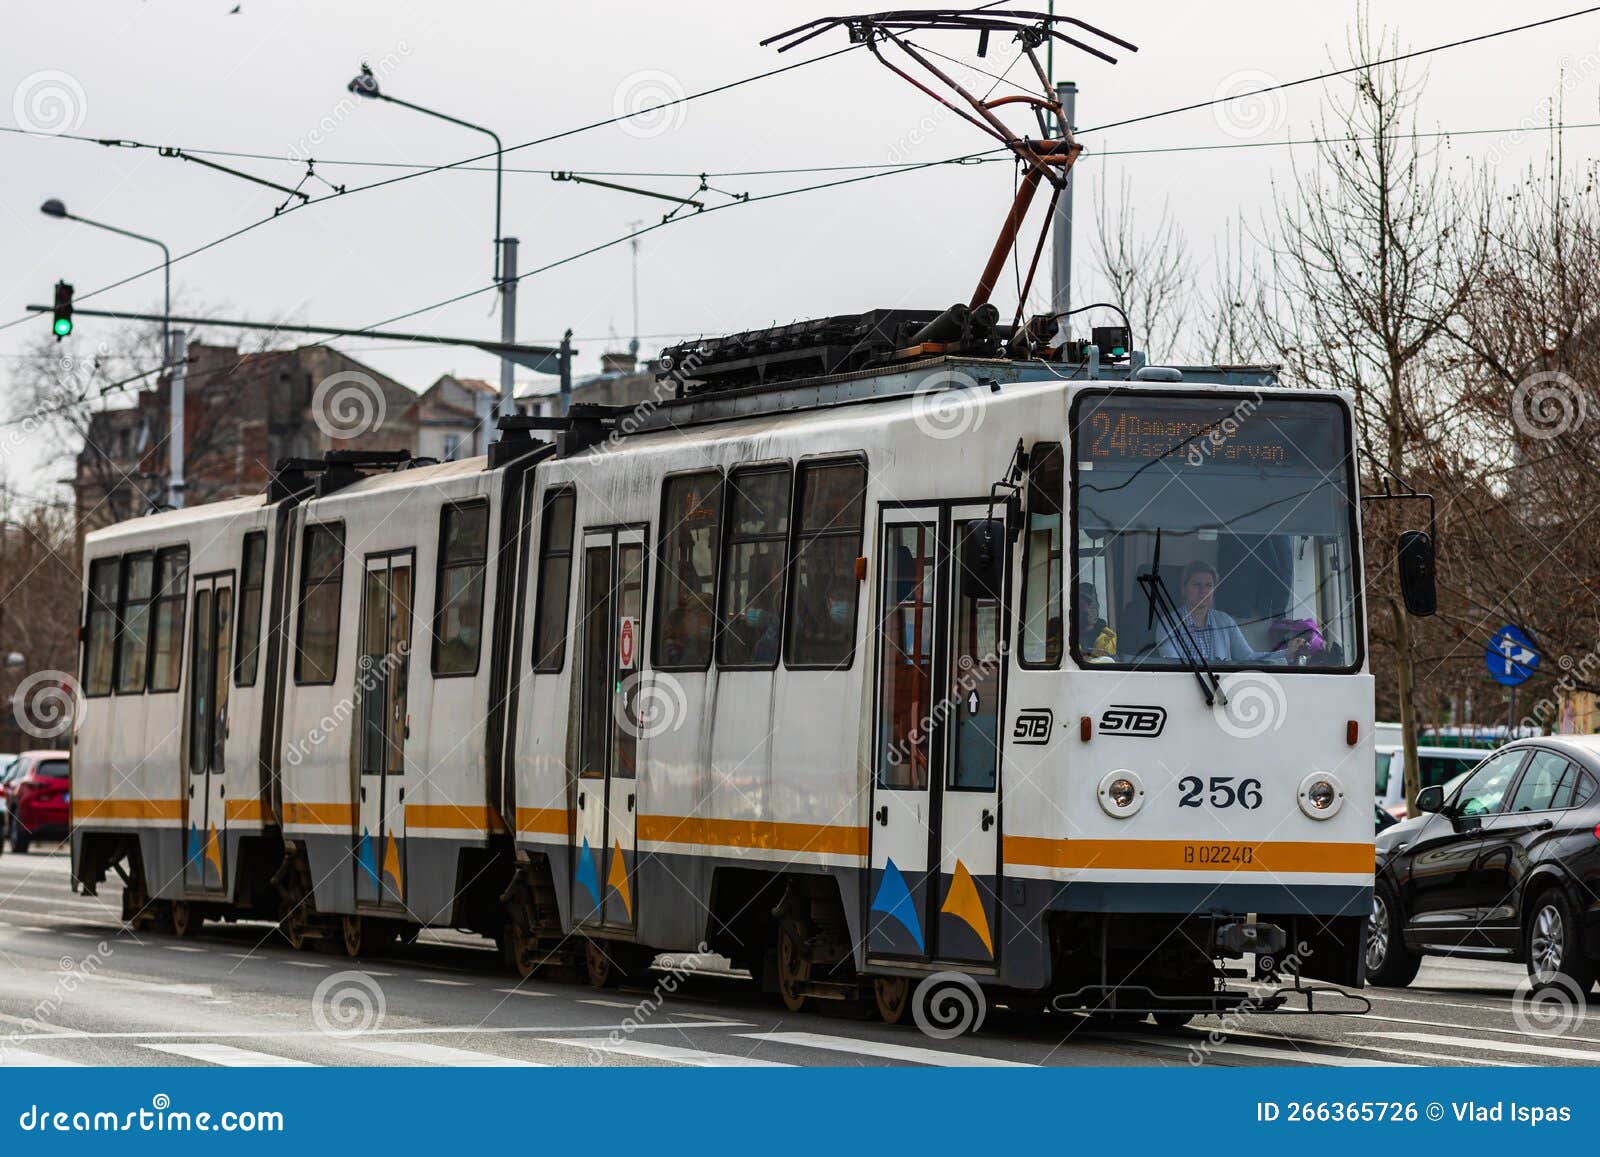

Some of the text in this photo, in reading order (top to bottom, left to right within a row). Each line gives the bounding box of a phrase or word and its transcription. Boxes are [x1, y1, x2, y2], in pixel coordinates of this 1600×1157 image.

[1090, 411, 1126, 456] 24
[1212, 442, 1284, 460] Parvan
[1013, 715, 1049, 738] STB
[1099, 710, 1160, 731] STB
[1178, 775, 1263, 810] 256
[1199, 846, 1253, 864] 02240
